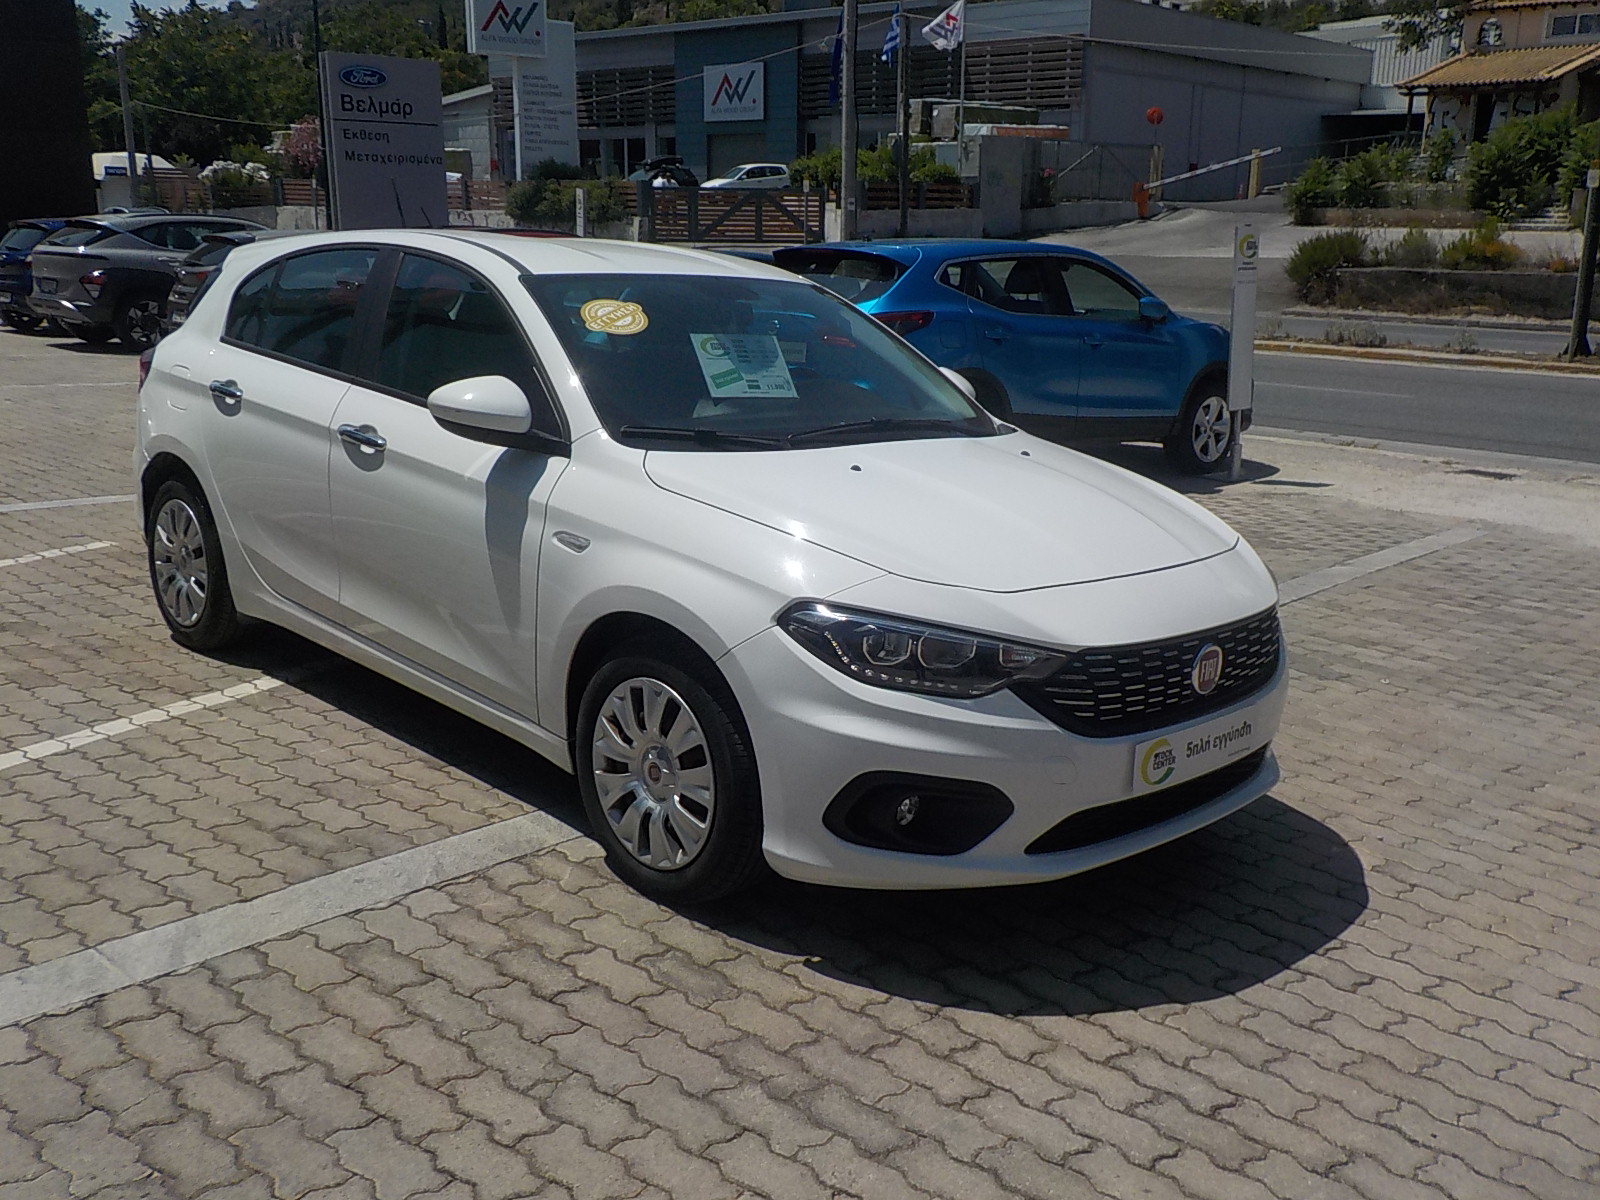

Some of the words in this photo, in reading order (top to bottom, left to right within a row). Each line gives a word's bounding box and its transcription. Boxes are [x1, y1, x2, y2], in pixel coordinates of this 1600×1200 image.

[350, 69, 380, 84] Ford
[340, 93, 414, 119] Βελμάρ
[344, 150, 443, 166] Μεταχειρισμένα
[589, 304, 637, 330] ΕΓΓΥΗΣΗ
[1200, 657, 1217, 682] FIAT
[1185, 735, 1211, 759] 5πλή
[1212, 720, 1252, 751] εγγύηση
[1152, 756, 1176, 771] CENTER
[1153, 748, 1174, 761] STOCK
